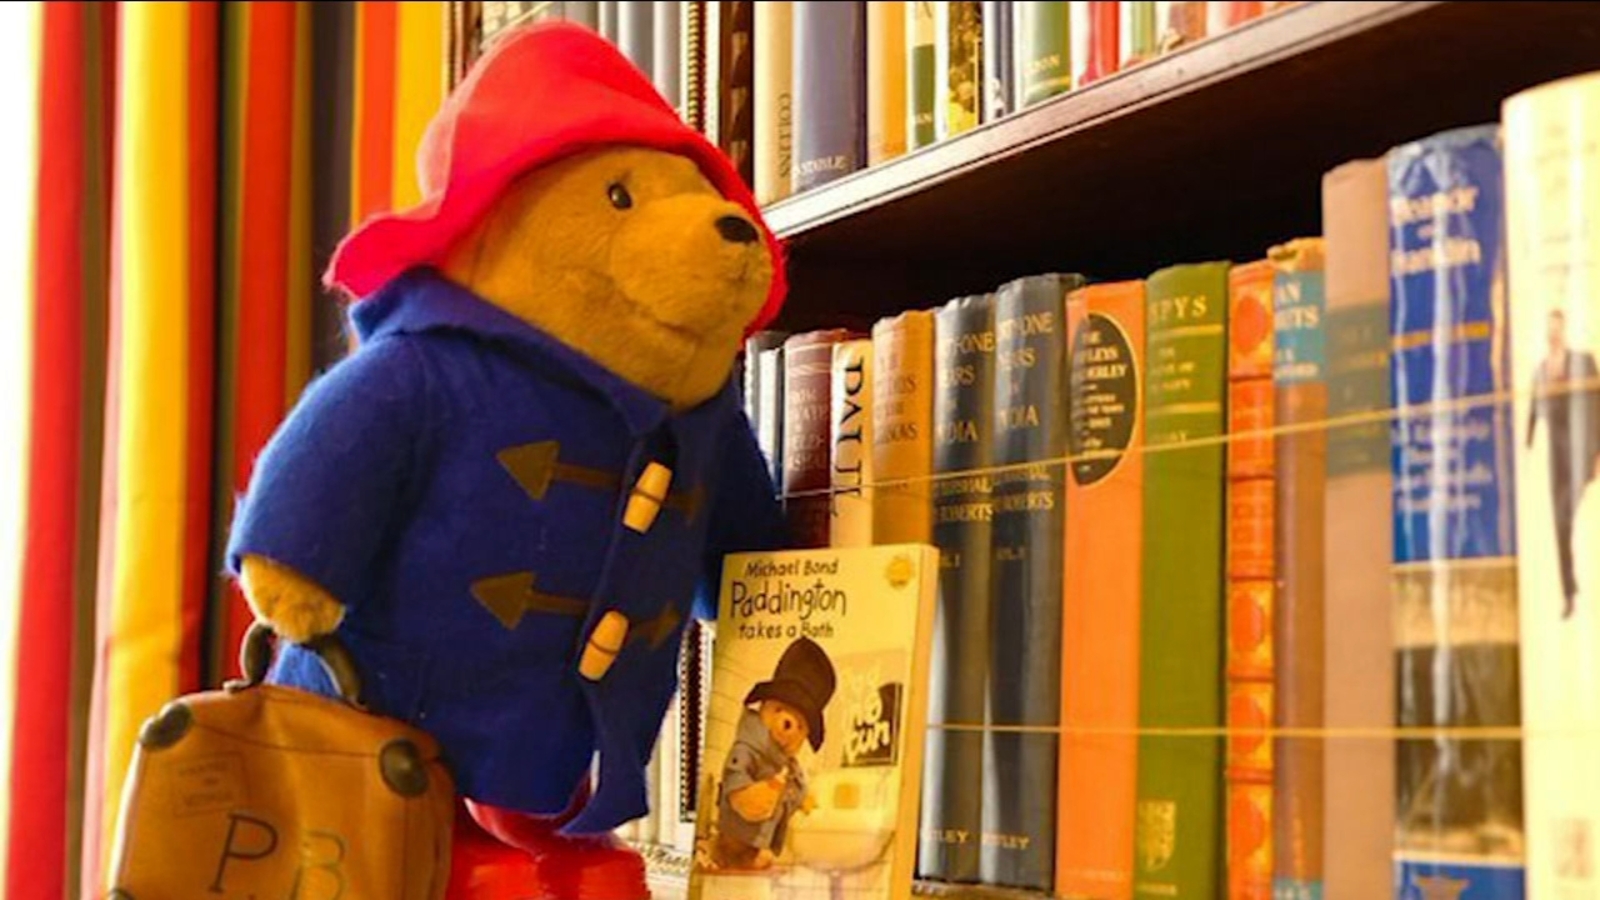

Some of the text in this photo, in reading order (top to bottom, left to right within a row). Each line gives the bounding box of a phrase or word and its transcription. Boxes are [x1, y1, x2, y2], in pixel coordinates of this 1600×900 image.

[778, 93, 792, 178] COLLINS
[744, 557, 839, 578] Michael Bond
[730, 578, 846, 621] Paddington
[739, 622, 782, 640] takes
[786, 629, 797, 638] a
